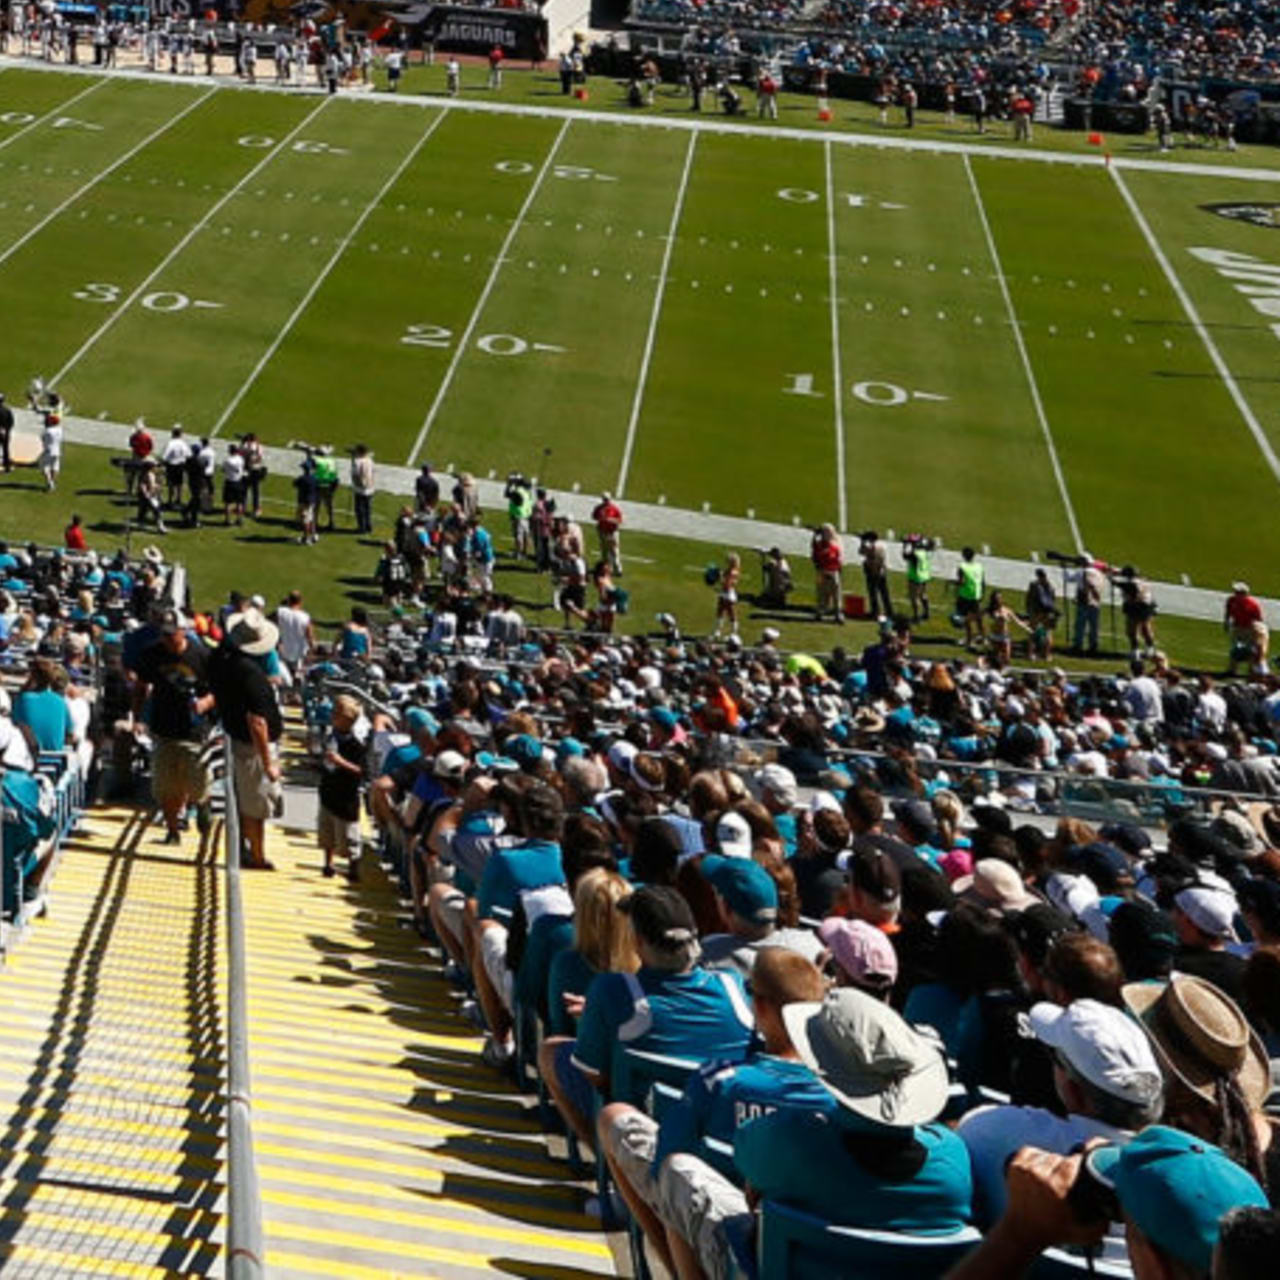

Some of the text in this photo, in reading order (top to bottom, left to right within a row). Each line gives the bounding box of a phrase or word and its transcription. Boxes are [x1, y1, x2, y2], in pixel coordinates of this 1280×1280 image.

[72, 282, 190, 313] 30
[400, 323, 528, 356] 20
[782, 372, 909, 406] 10
